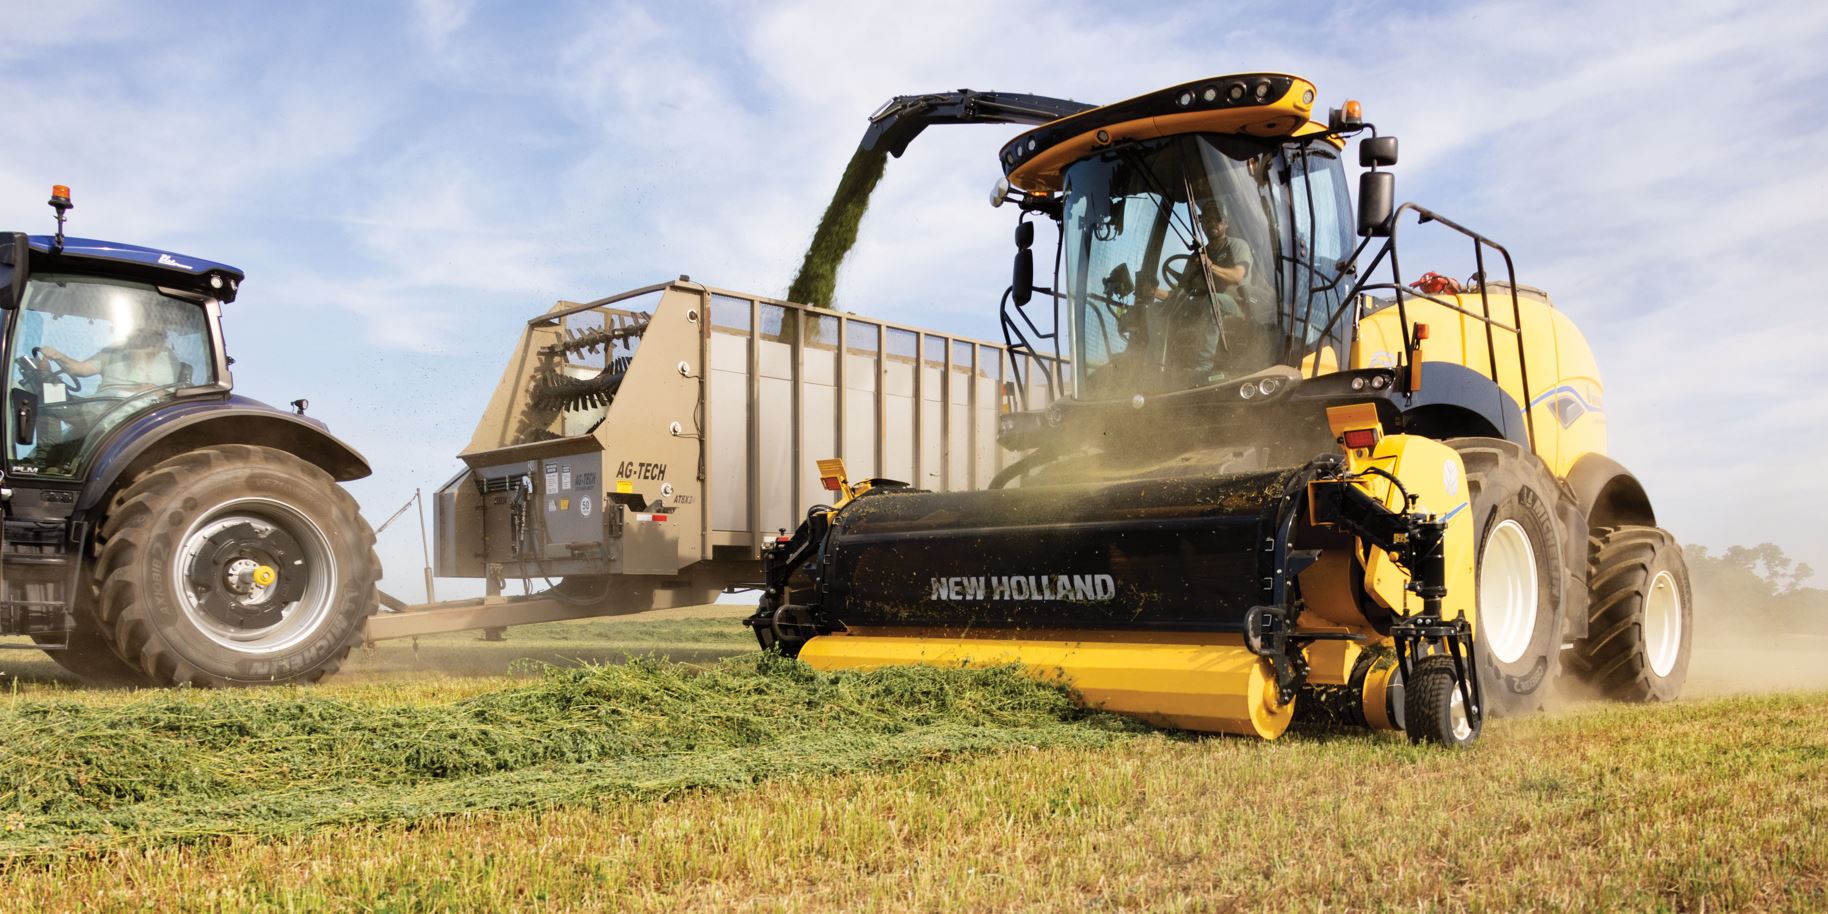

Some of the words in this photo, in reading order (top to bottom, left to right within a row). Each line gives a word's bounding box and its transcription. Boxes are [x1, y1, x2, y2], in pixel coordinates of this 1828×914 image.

[616, 461, 667, 481] AG-TECH
[582, 501, 590, 511] 50
[1532, 499, 1561, 597] MICHELIN
[931, 576, 985, 601] NEW
[990, 574, 1116, 602] HOLLAND
[249, 614, 348, 675] MICHELIN
